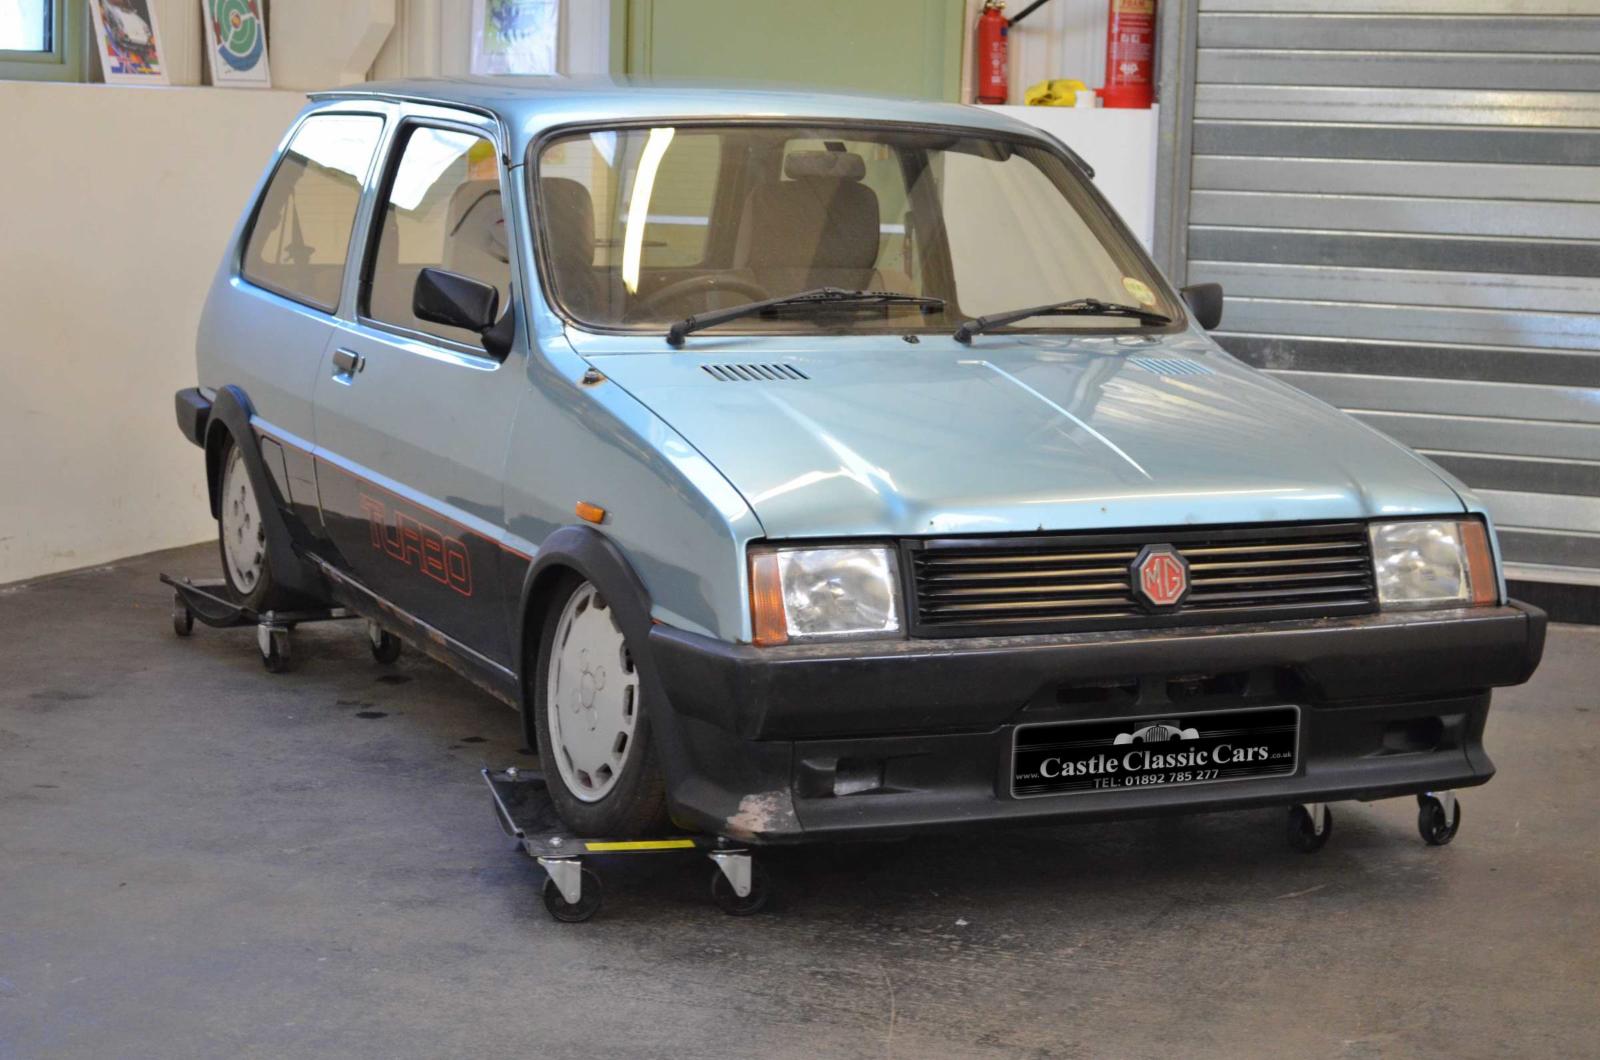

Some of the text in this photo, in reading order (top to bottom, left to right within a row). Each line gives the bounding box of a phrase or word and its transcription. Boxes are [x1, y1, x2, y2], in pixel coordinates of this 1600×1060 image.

[360, 492, 472, 597] TURBO
[1145, 558, 1181, 598] MG
[1040, 754, 1119, 778] Castle
[1123, 747, 1208, 771] Classic
[1212, 744, 1269, 764] Cars
[1093, 769, 1219, 788] TEL: 01892 785 277
